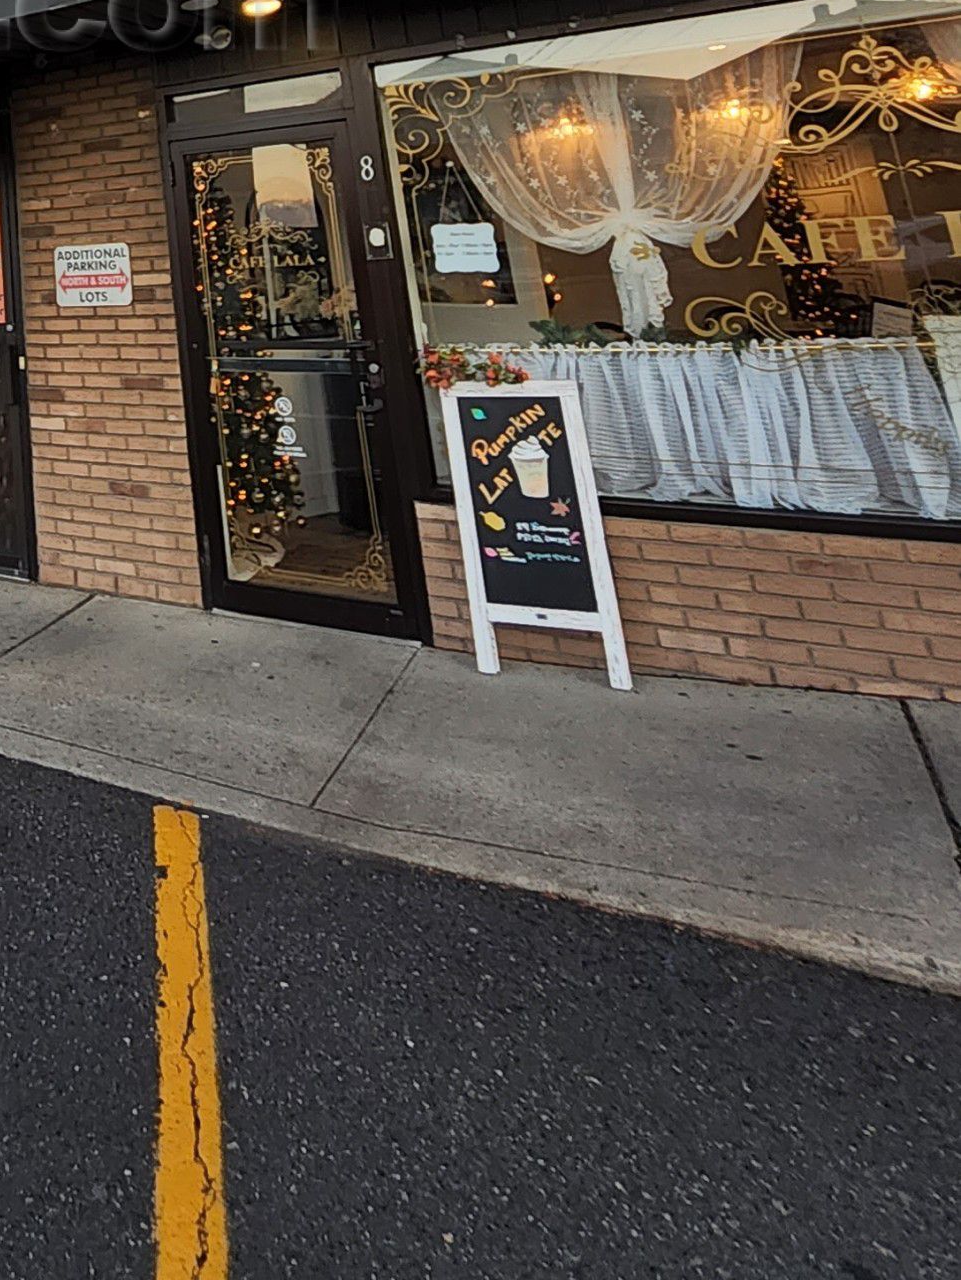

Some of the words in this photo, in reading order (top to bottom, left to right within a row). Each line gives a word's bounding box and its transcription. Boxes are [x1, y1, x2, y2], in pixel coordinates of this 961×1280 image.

[359, 155, 376, 182] 8
[691, 214, 906, 269] CAFE
[57, 248, 127, 261] ADDITIONAL
[67, 260, 117, 272] PARKING
[97, 275, 126, 285] SOUTH
[79, 291, 108, 303] LOTS
